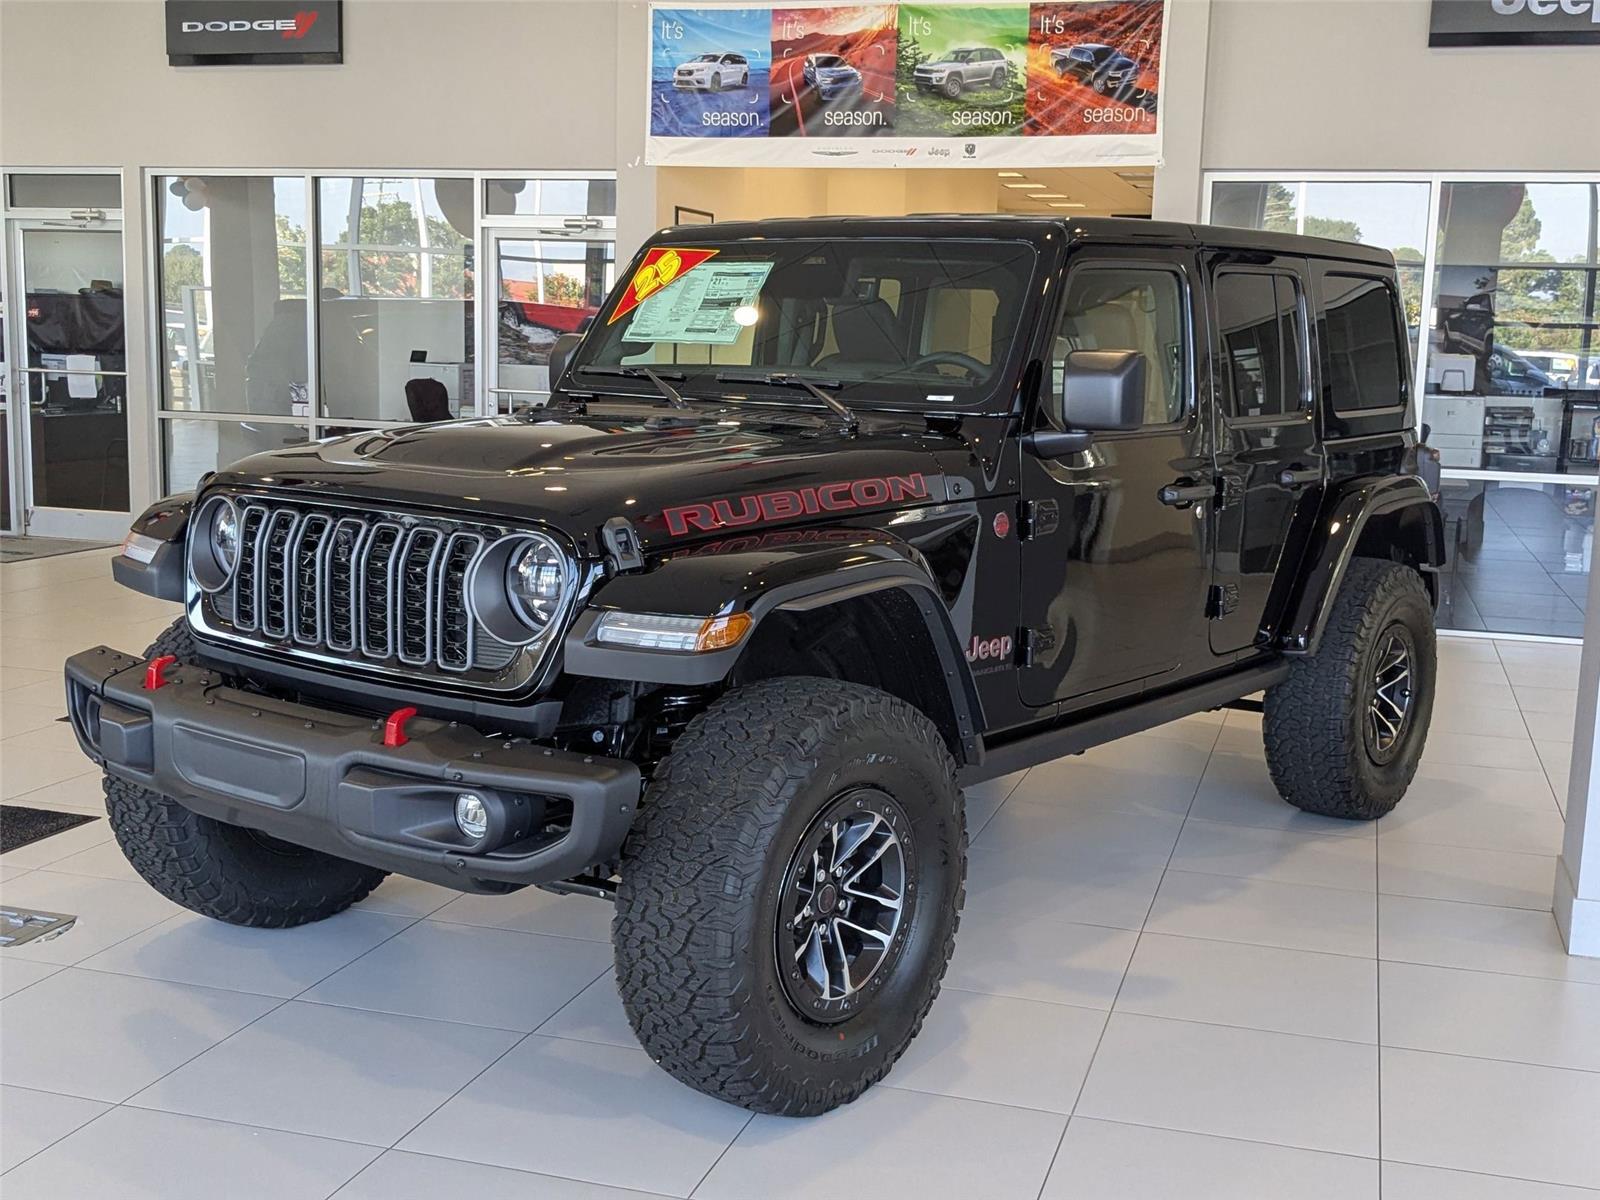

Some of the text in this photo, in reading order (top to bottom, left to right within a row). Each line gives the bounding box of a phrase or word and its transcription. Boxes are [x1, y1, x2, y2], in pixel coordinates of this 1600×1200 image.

[182, 20, 297, 33] DODGE
[661, 20, 684, 40] It's
[782, 20, 805, 40] It's
[909, 16, 931, 36] It's
[1041, 15, 1064, 35] It's
[702, 112, 764, 127] season.
[824, 110, 887, 126] season.
[952, 110, 1016, 126] season.
[1083, 107, 1150, 123] season.
[634, 250, 681, 301] 25
[663, 473, 927, 536] RUBICON
[965, 634, 1013, 662] Jeep
